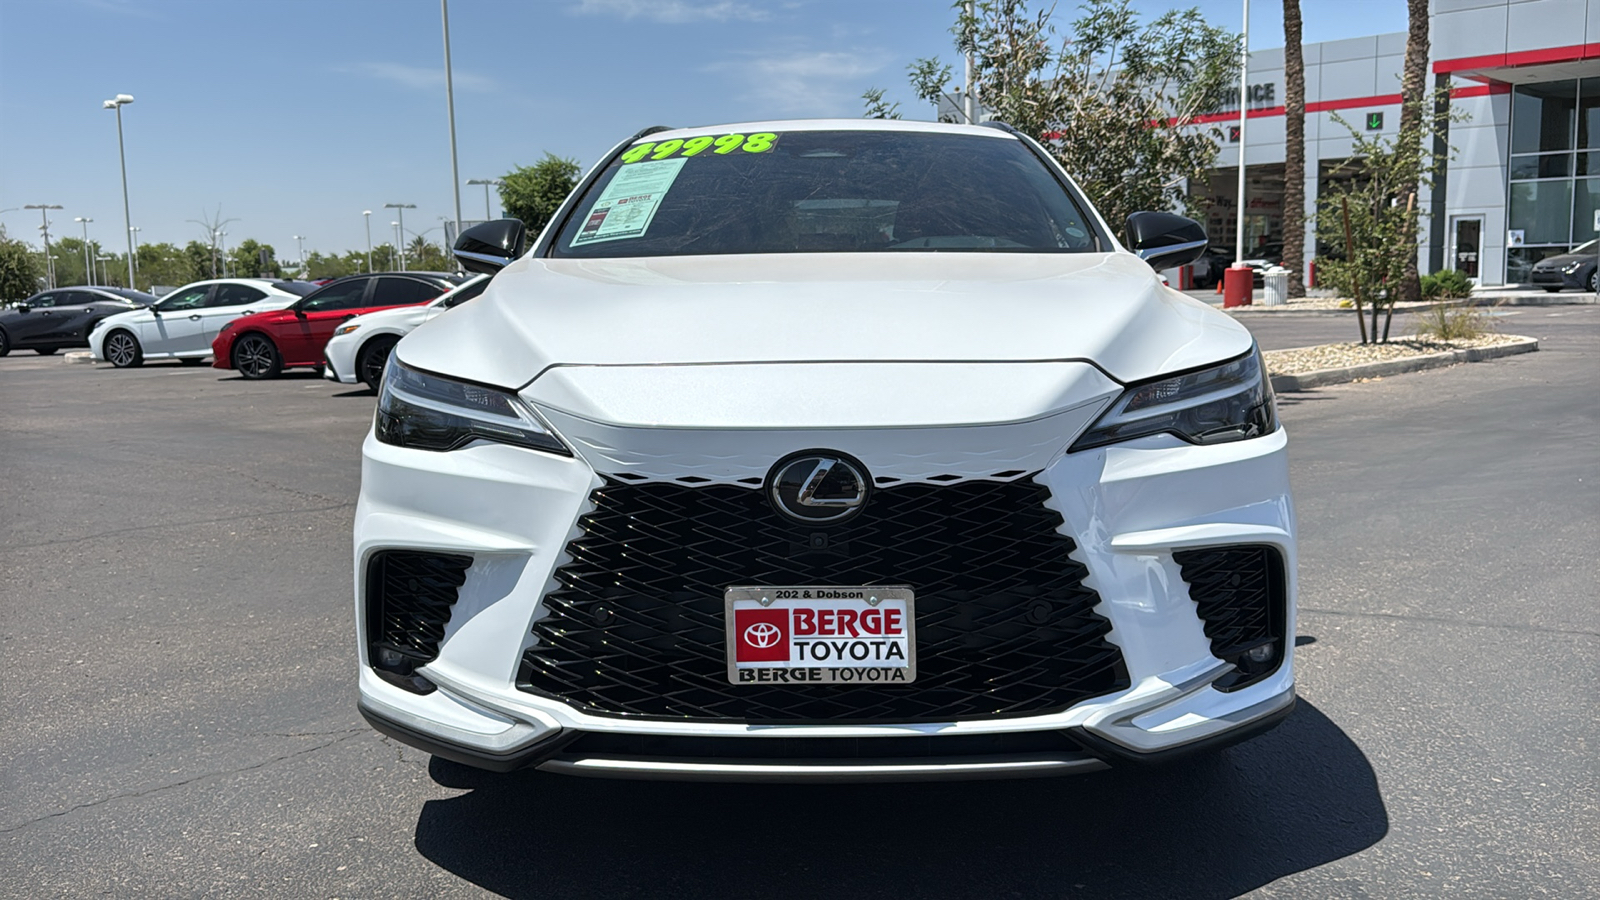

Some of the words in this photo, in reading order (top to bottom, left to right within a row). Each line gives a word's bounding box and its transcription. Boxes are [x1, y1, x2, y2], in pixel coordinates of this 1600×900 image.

[621, 132, 777, 163] 49998
[775, 590, 799, 599] 202
[803, 590, 812, 599] &
[816, 590, 863, 599] Dobson
[792, 608, 903, 638] BERGE
[793, 641, 905, 660] TOYOTA
[738, 667, 822, 682] BERGE
[828, 667, 905, 682] TOYOTA
